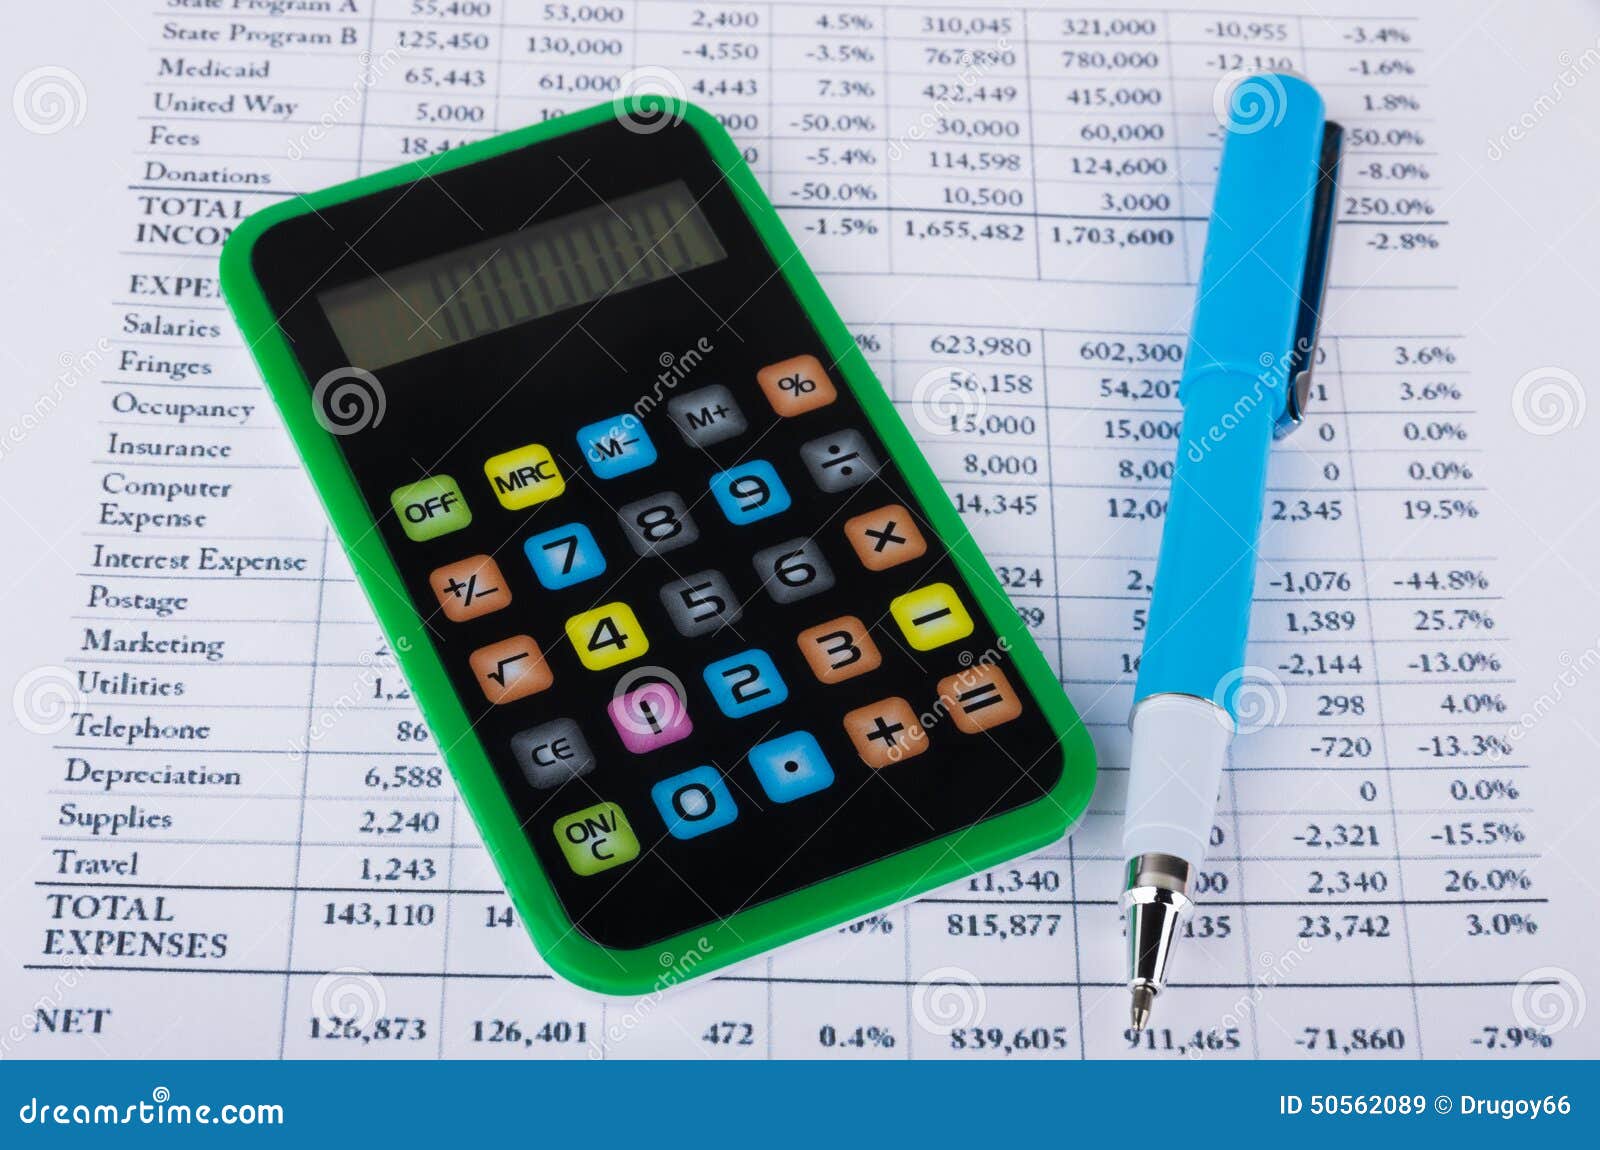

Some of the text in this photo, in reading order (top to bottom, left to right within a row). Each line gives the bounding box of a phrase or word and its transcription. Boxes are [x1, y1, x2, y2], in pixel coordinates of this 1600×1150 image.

[543, 6, 623, 24] 53,000
[694, 11, 759, 29] 2,400
[817, 14, 873, 31] 4.5%
[922, 17, 1012, 35] 310,045
[1062, 19, 1155, 37] 321,000
[1343, 28, 1410, 44] -3.4%
[162, 22, 220, 42] State
[230, 23, 332, 48] Program
[340, 27, 358, 45] B
[399, 31, 489, 51] 125,450
[526, 37, 622, 56] 130,000
[682, 43, 759, 62] -4,550
[805, 46, 874, 63] -3.5%
[1062, 51, 1158, 71] 780,000
[1349, 59, 1414, 76] -1.6%
[157, 58, 270, 79] Medicaid
[405, 68, 486, 88] 65,443
[539, 74, 620, 94] 61,000
[818, 79, 875, 97] 7.3%
[1067, 88, 1162, 108] 415,000
[1364, 94, 1419, 112] 1.8%
[153, 93, 239, 115] United
[242, 95, 299, 120] Way
[416, 103, 485, 123] 5,000
[789, 114, 876, 131] -50.0%
[936, 118, 1019, 139] 30,000
[1081, 123, 1164, 143] 60,000
[149, 126, 200, 148] Fees
[806, 148, 876, 165] -5.4%
[930, 151, 1020, 172] 114,598
[1070, 156, 1167, 177] 124,600
[1358, 163, 1430, 180] -8.0%
[144, 161, 271, 186] Donations
[791, 184, 878, 202] -50.0%
[943, 187, 1023, 208] 10,500
[1100, 193, 1170, 213] 3,000
[138, 195, 1439, 250] TOTAL -1.5% 1,655,482 1,703,600 -2.8%
[129, 274, 222, 299] EXPE
[122, 313, 1456, 366] Salaries 623,980 602,300 3.6%
[118, 350, 212, 381] Fringes
[950, 372, 1033, 395] 56,158
[1400, 382, 1462, 401] 3.6%
[111, 391, 256, 424] Occupancy
[951, 414, 1035, 436] 15,000
[1403, 422, 1468, 442] 0.0%
[107, 432, 232, 458] Insurance
[964, 454, 1038, 477] 8,000
[1408, 461, 1473, 481] 0.0%
[495, 459, 556, 495] MRC
[101, 472, 232, 502] Computer
[955, 493, 1038, 516] 14,345
[1271, 500, 1343, 523] 2,345
[1404, 500, 1480, 520] 19.5%
[404, 491, 459, 525] OFF
[728, 475, 771, 512] 9
[99, 502, 207, 533] Expense
[637, 505, 682, 540] 8
[92, 544, 190, 570] Interest
[198, 547, 308, 577] Expense
[1269, 571, 1351, 595] -1,076
[1393, 570, 1489, 591] -44.8%
[542, 535, 580, 574] 7
[775, 550, 816, 588] 6
[86, 584, 1495, 635] Postage 1,389 25.7%
[680, 581, 725, 623] 5
[80, 628, 1501, 677] Marketing -2,144 -13.0%
[587, 616, 628, 651] 4
[816, 629, 863, 670] 3
[77, 670, 1507, 715] Utilities 298 4.0%
[721, 663, 773, 703] 2
[71, 712, 210, 745] Telephone
[1310, 737, 1372, 758] -720
[641, 699, 663, 735] 1
[531, 736, 573, 767] CE
[64, 758, 241, 791] Depreciation
[364, 766, 443, 791] 6,588
[1450, 780, 1520, 801] 0.0%
[672, 783, 716, 822] 0
[58, 803, 1526, 849] Supplies 2,240 -2,321 -15.5%
[53, 849, 138, 877] Travel
[360, 858, 437, 882] 1,243
[1307, 871, 1388, 895] 2,340
[1444, 869, 1532, 893] 26.0%
[47, 894, 1538, 942] TOTAL 143,110 815,877 23,742 3.0%
[42, 929, 229, 959] EXPENSES
[33, 1008, 113, 1035] NET
[309, 1016, 427, 1045] 126,873
[472, 1020, 588, 1048] 126,401
[702, 1022, 755, 1046] 472
[819, 1025, 896, 1049] 0.4%
[950, 1027, 1067, 1055] 839,605
[1295, 1027, 1406, 1055] -71,860
[1471, 1026, 1554, 1050] -7.9%
